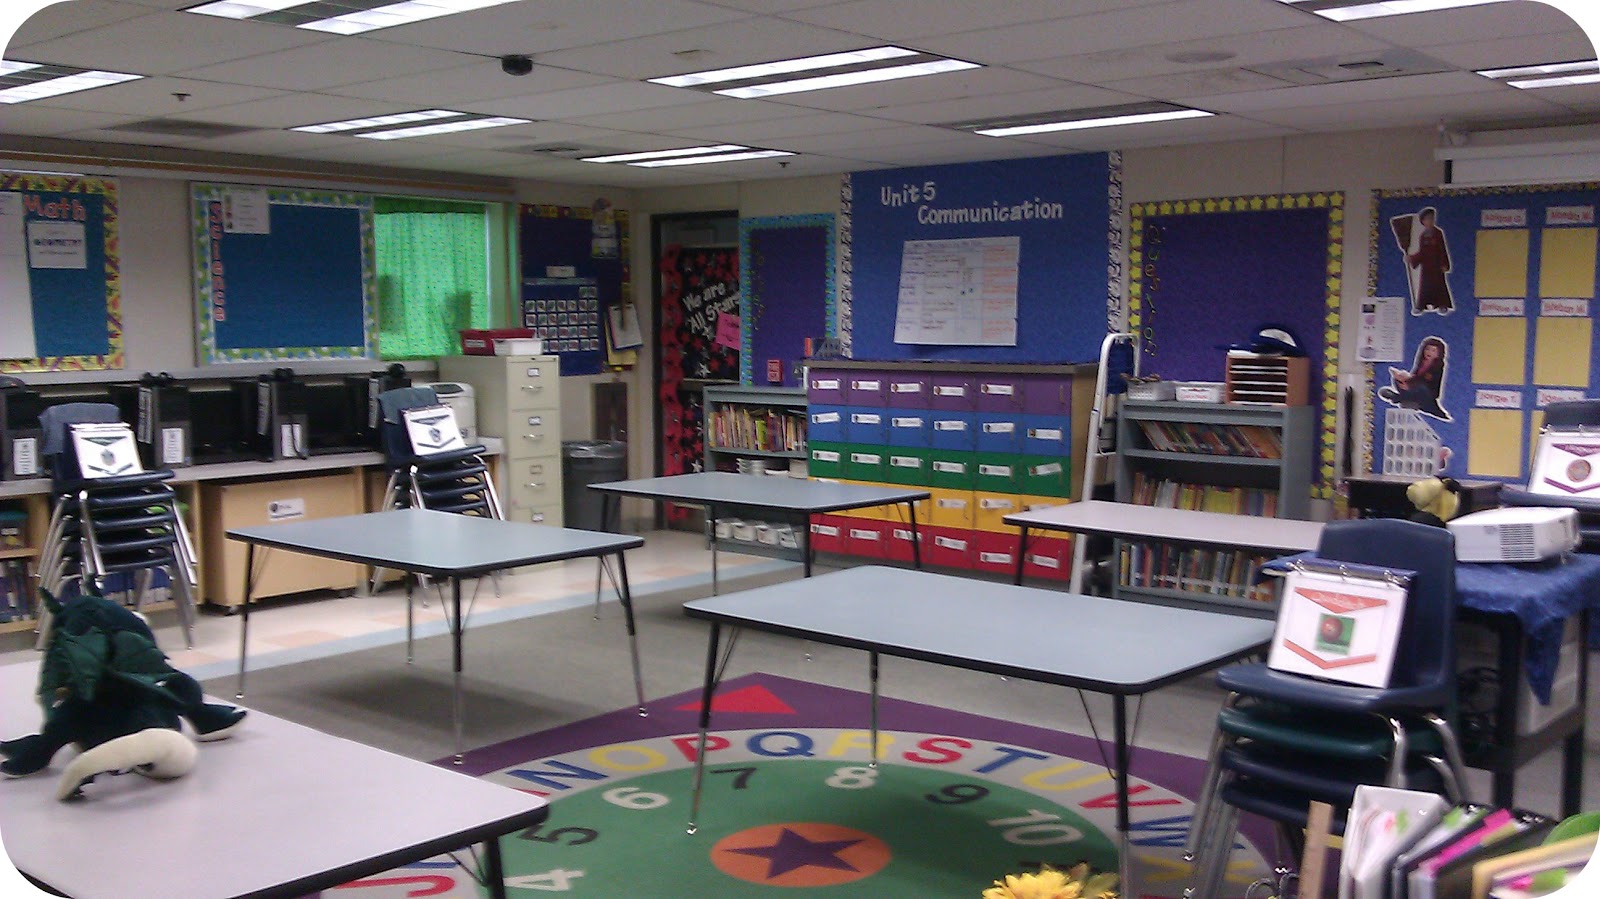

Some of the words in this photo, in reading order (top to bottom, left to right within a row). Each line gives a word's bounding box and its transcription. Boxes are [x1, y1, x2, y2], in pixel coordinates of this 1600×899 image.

[881, 184, 919, 207] Unit
[923, 181, 936, 201] 5
[23, 194, 87, 221] Math
[917, 197, 1063, 225] Communication
[209, 201, 226, 322] Science
[682, 293, 702, 312] We
[703, 283, 726, 301] are
[688, 312, 706, 334] All
[506, 760, 608, 790] N
[589, 744, 668, 772] O
[670, 735, 731, 762] P
[746, 731, 816, 757] Q
[829, 731, 895, 759] R
[902, 737, 972, 764] S
[976, 746, 1047, 774] T
[1022, 763, 1117, 791] U
[1079, 785, 1182, 809] V
[711, 767, 757, 789] 7
[825, 767, 877, 789] 8
[602, 787, 669, 810] 6
[926, 784, 989, 804] 9
[518, 826, 599, 846] 5
[987, 808, 1084, 846] 10
[503, 869, 584, 891] 4
